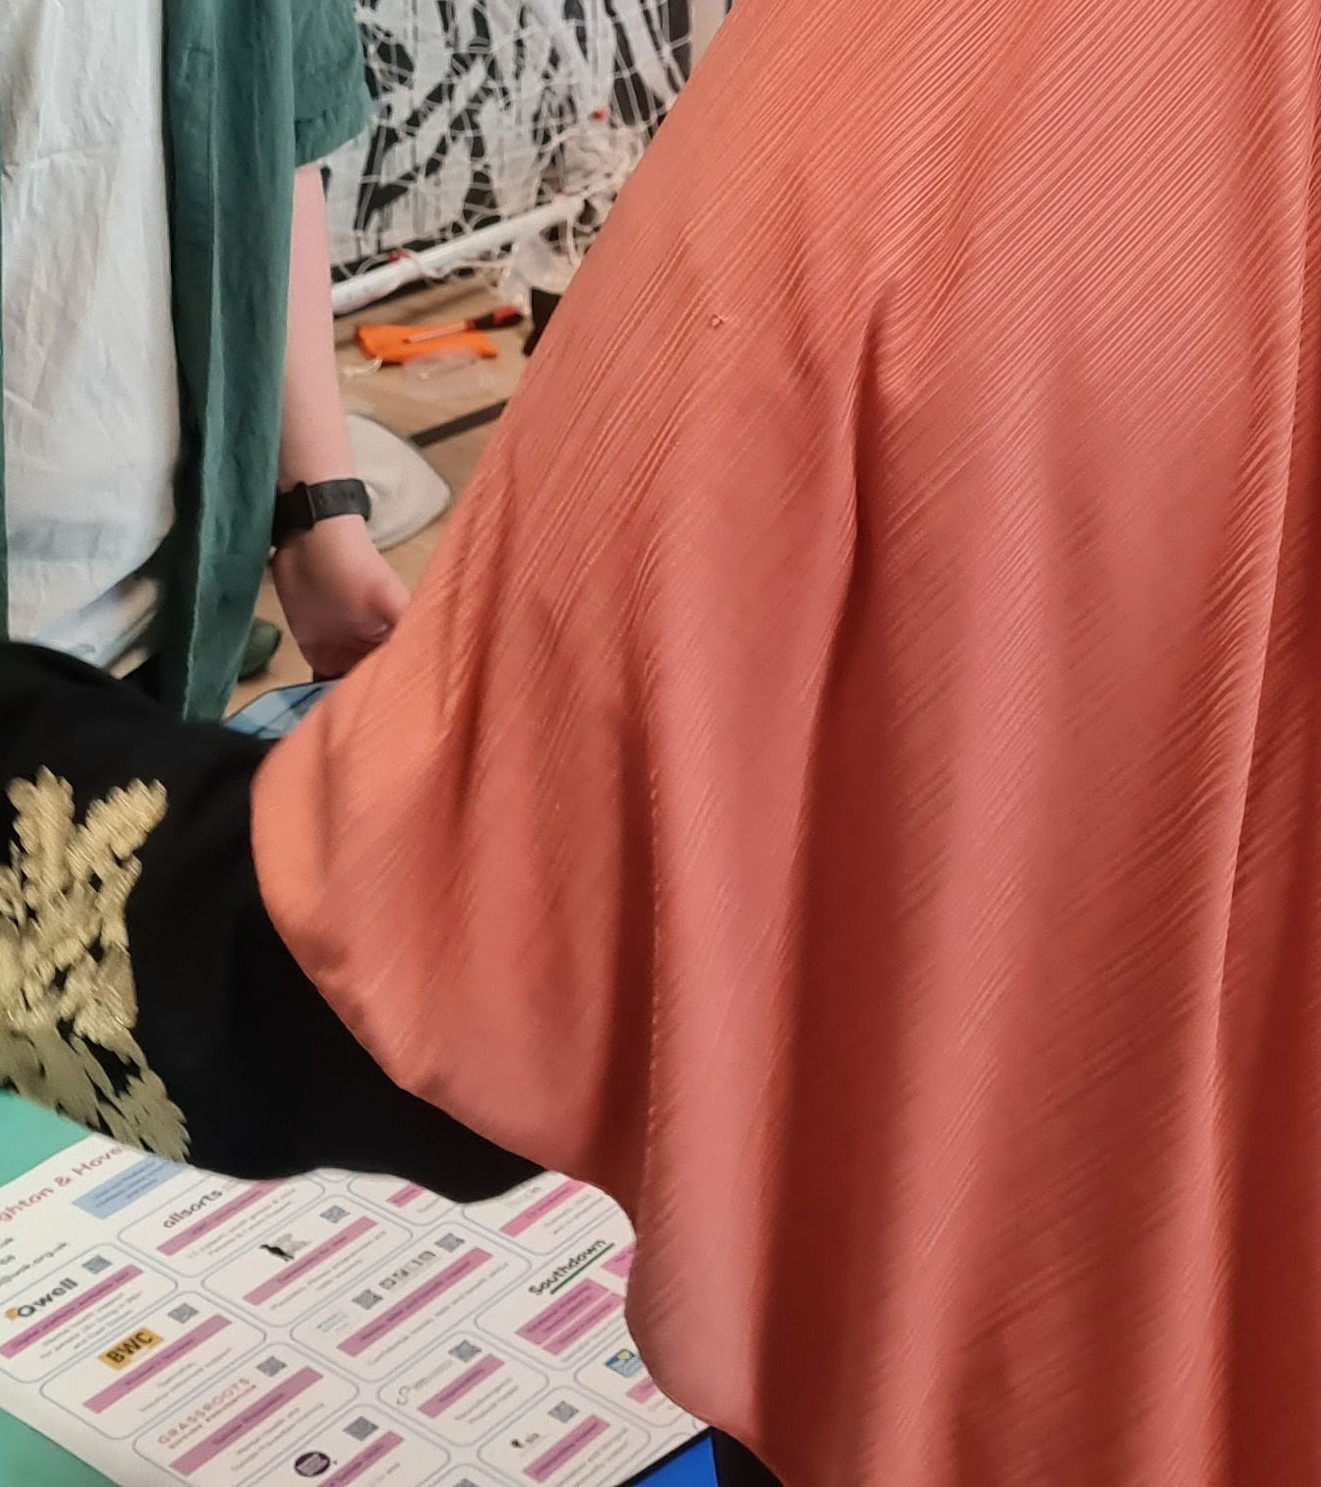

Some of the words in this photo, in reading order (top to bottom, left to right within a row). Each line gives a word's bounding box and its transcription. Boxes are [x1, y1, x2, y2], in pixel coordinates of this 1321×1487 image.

[54, 1174, 73, 1188] &
[71, 1144, 124, 1177] Hove
[162, 1189, 223, 1229] allsorts
[528, 1239, 607, 1296] Southdown
[17, 1277, 79, 1318] Qwell
[105, 1331, 153, 1364] BWC
[158, 1377, 251, 1445] GRASSROOTS
